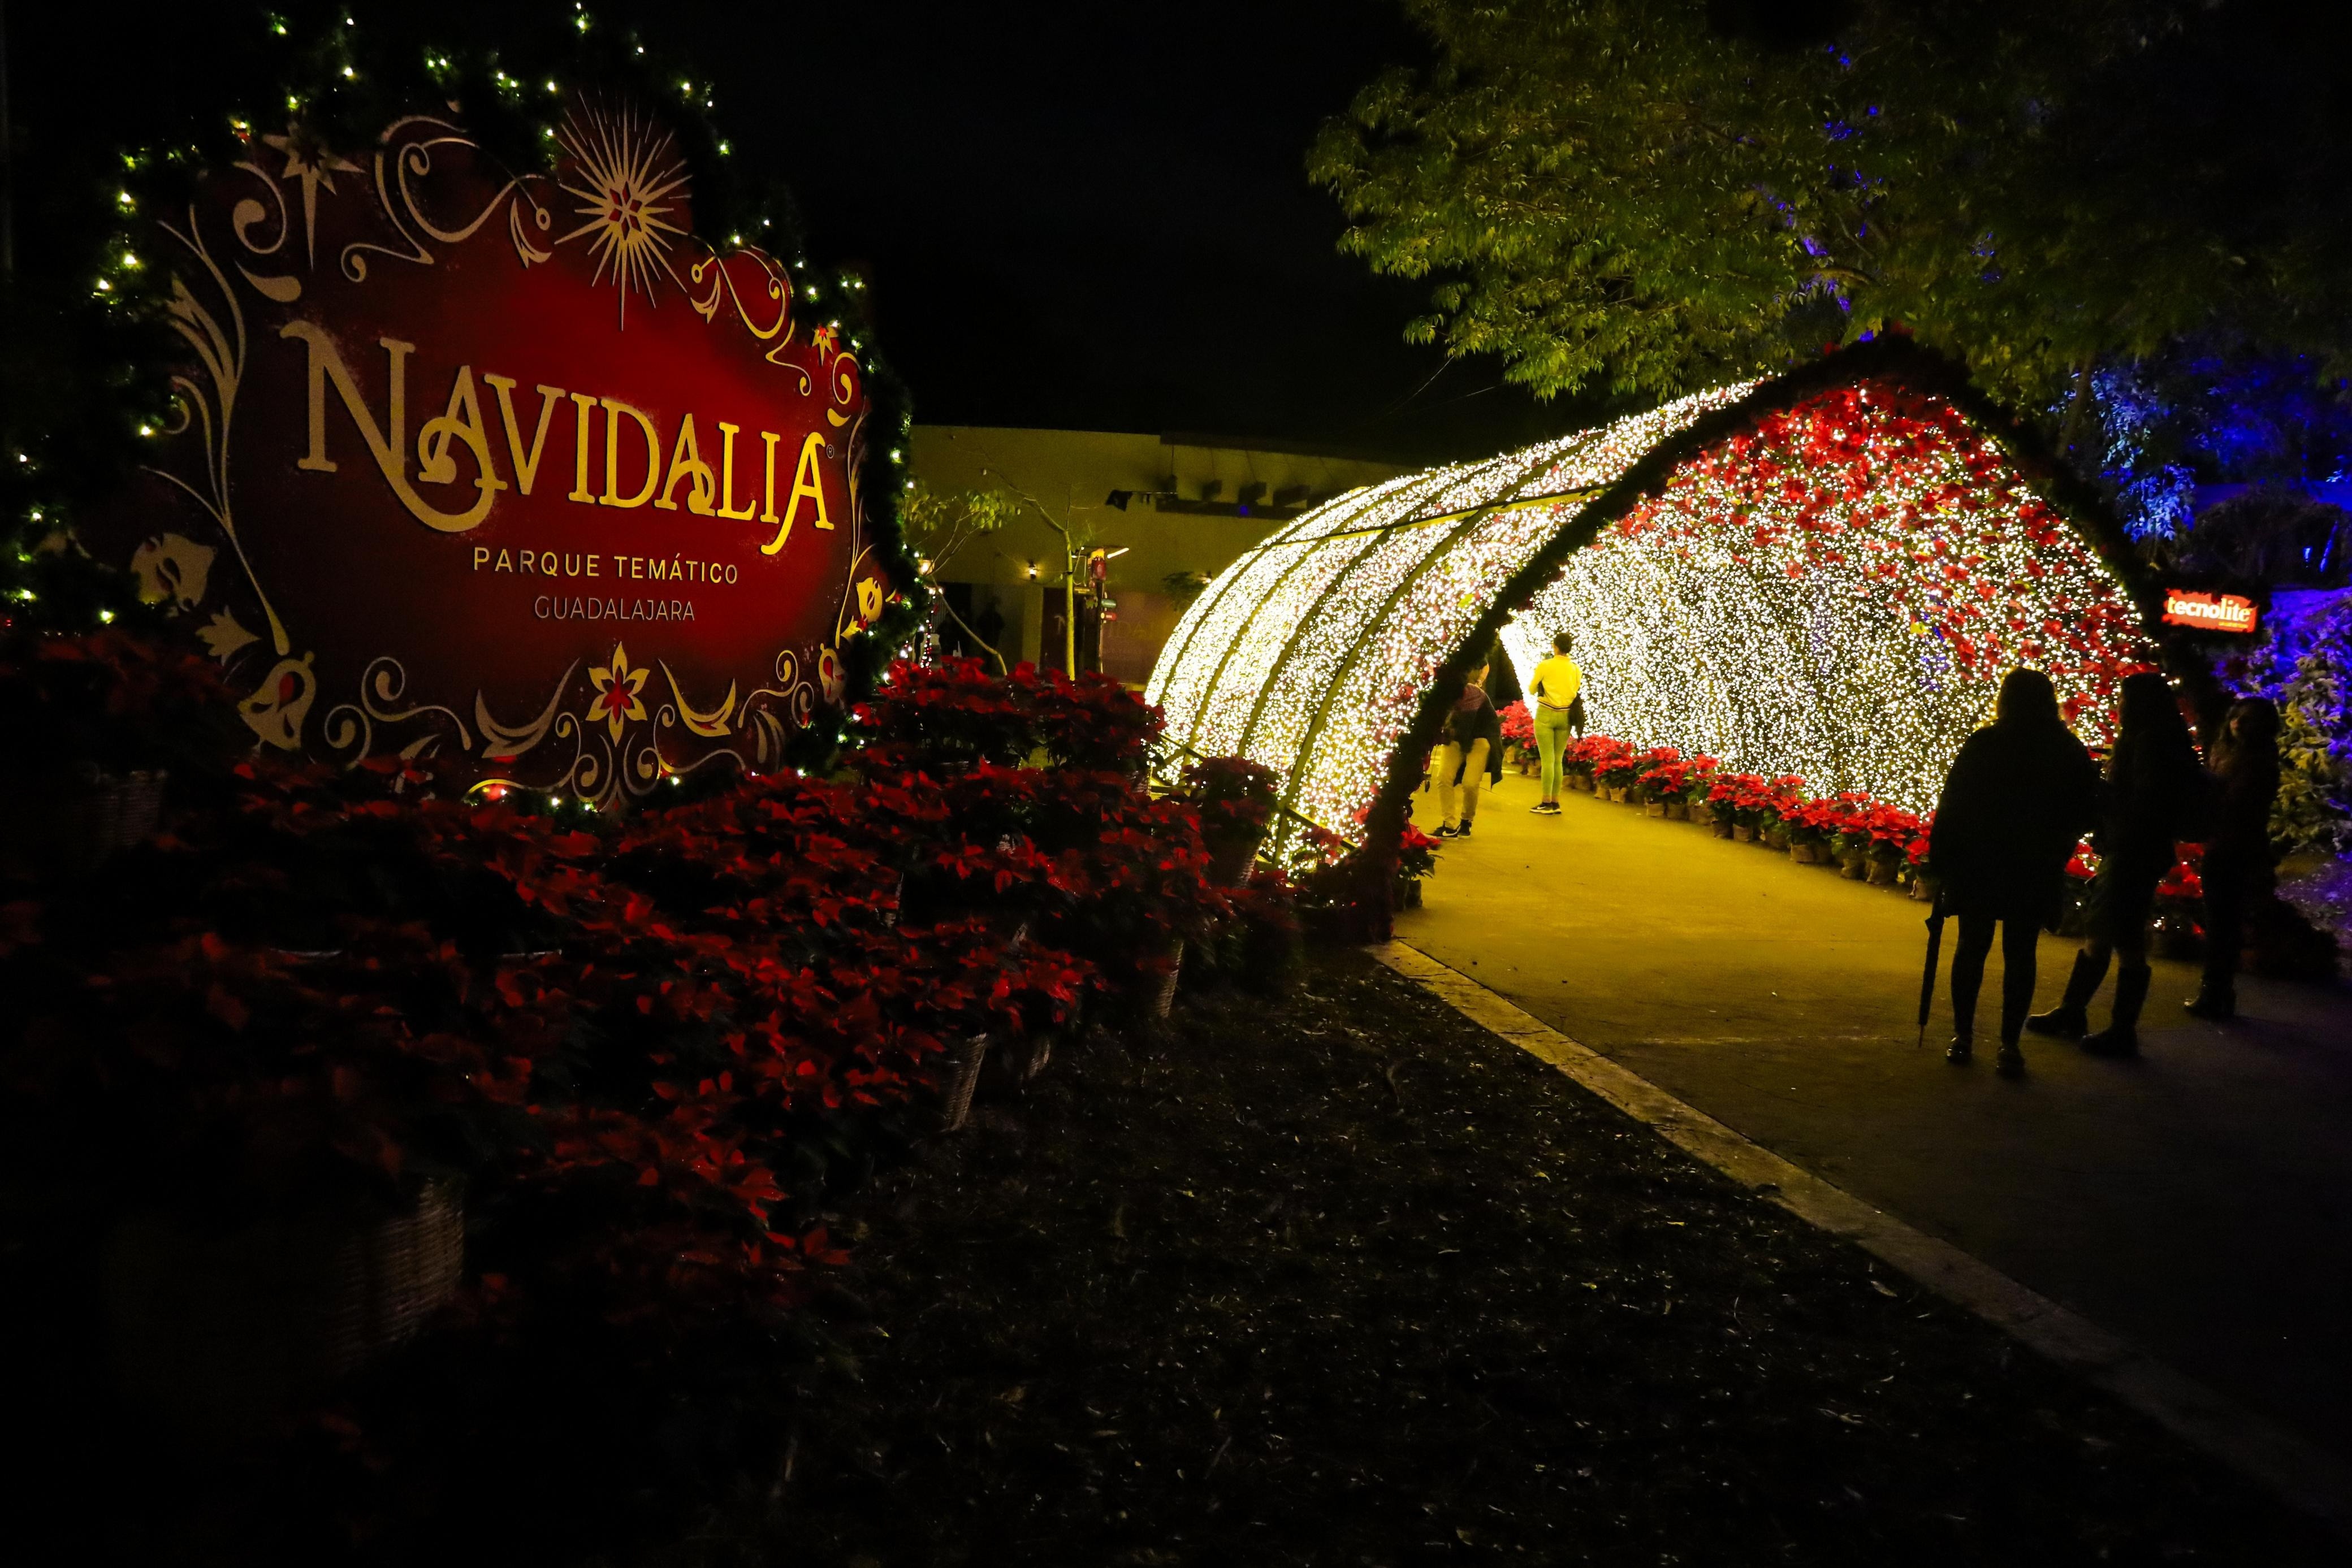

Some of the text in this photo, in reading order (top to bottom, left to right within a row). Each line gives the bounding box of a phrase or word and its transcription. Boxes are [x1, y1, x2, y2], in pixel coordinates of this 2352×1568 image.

[279, 320, 835, 555] NAVIDALIA
[473, 547, 738, 584] PARQUE TEMÁTICO
[534, 595, 695, 621] GUADALAJARA
[2167, 596, 2251, 622] tecnolite
